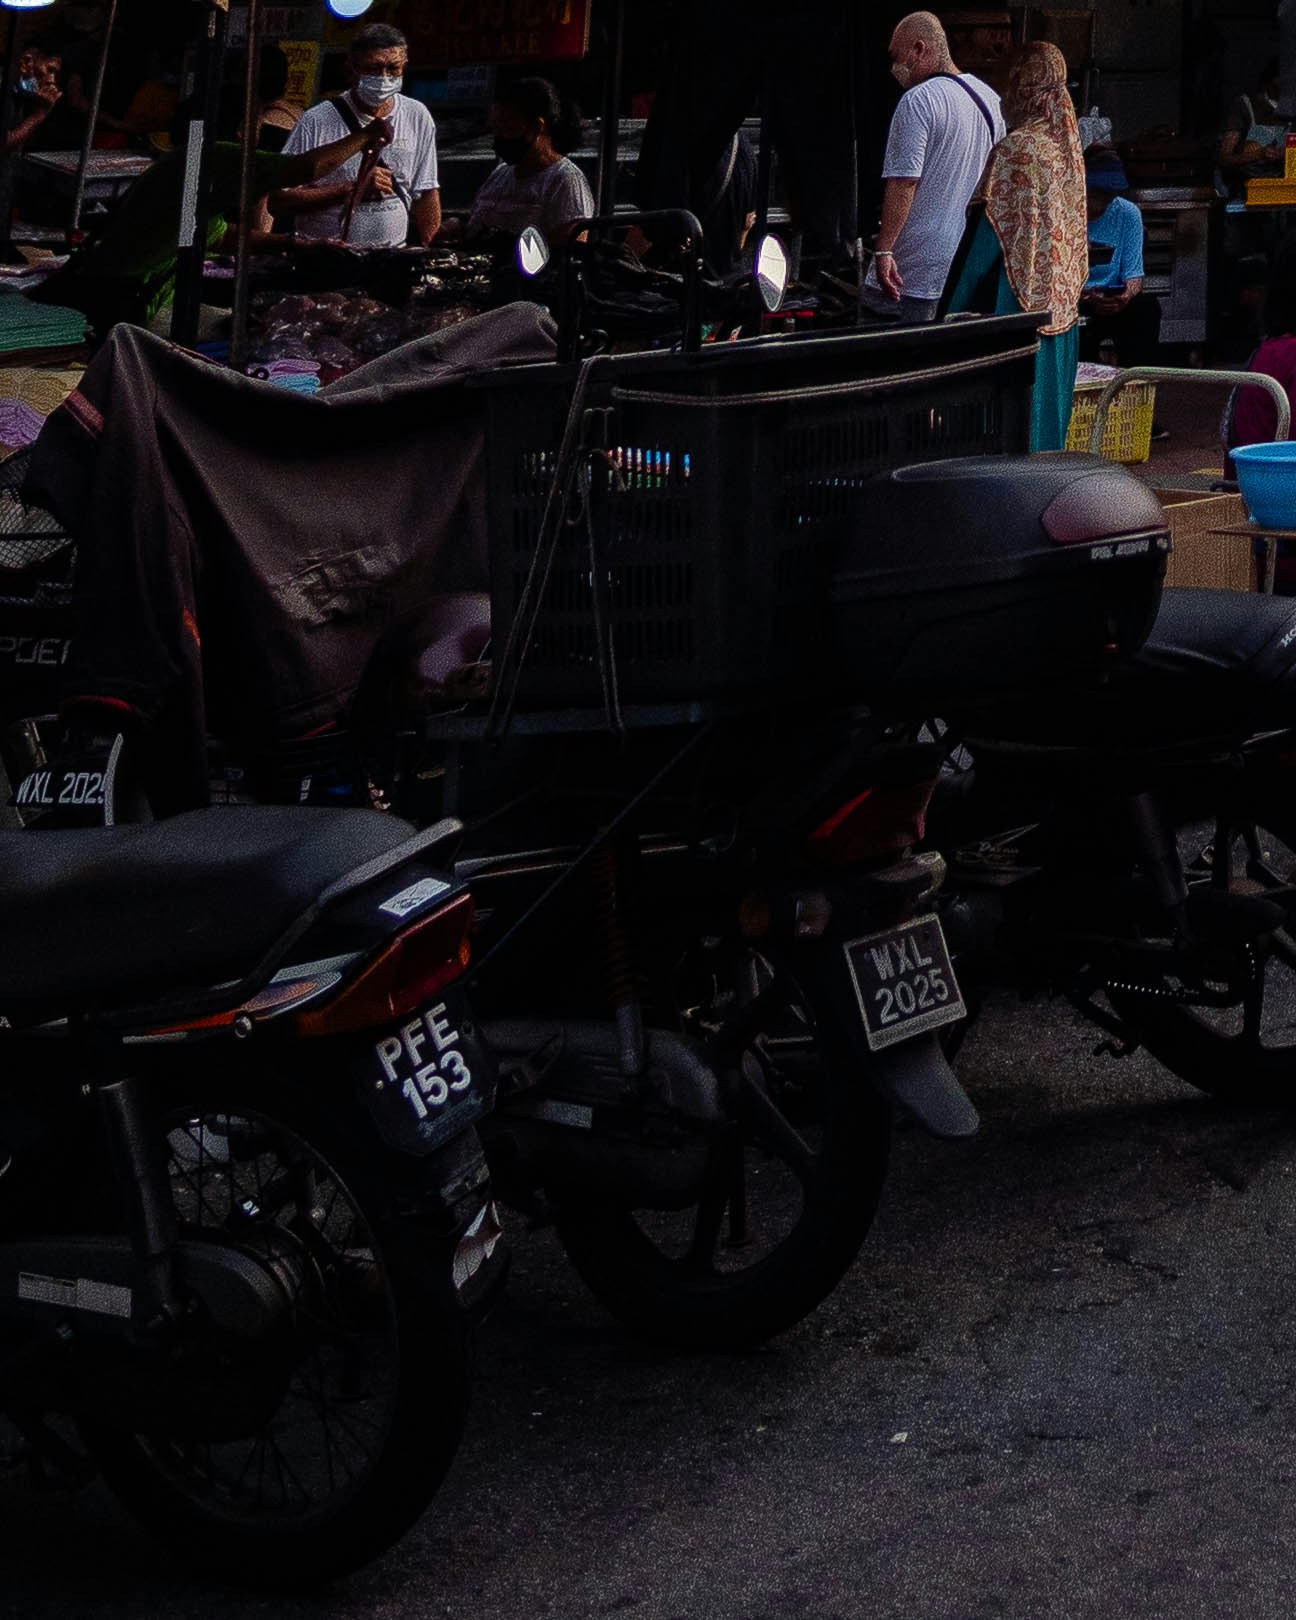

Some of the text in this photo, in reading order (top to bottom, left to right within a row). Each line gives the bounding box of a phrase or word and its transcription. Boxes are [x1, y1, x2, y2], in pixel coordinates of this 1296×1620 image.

[17, 771, 54, 805] WXL
[870, 935, 933, 981] WXL
[874, 967, 950, 1026] 2025
[374, 1001, 460, 1083] PFE
[402, 1049, 473, 1120] 153
